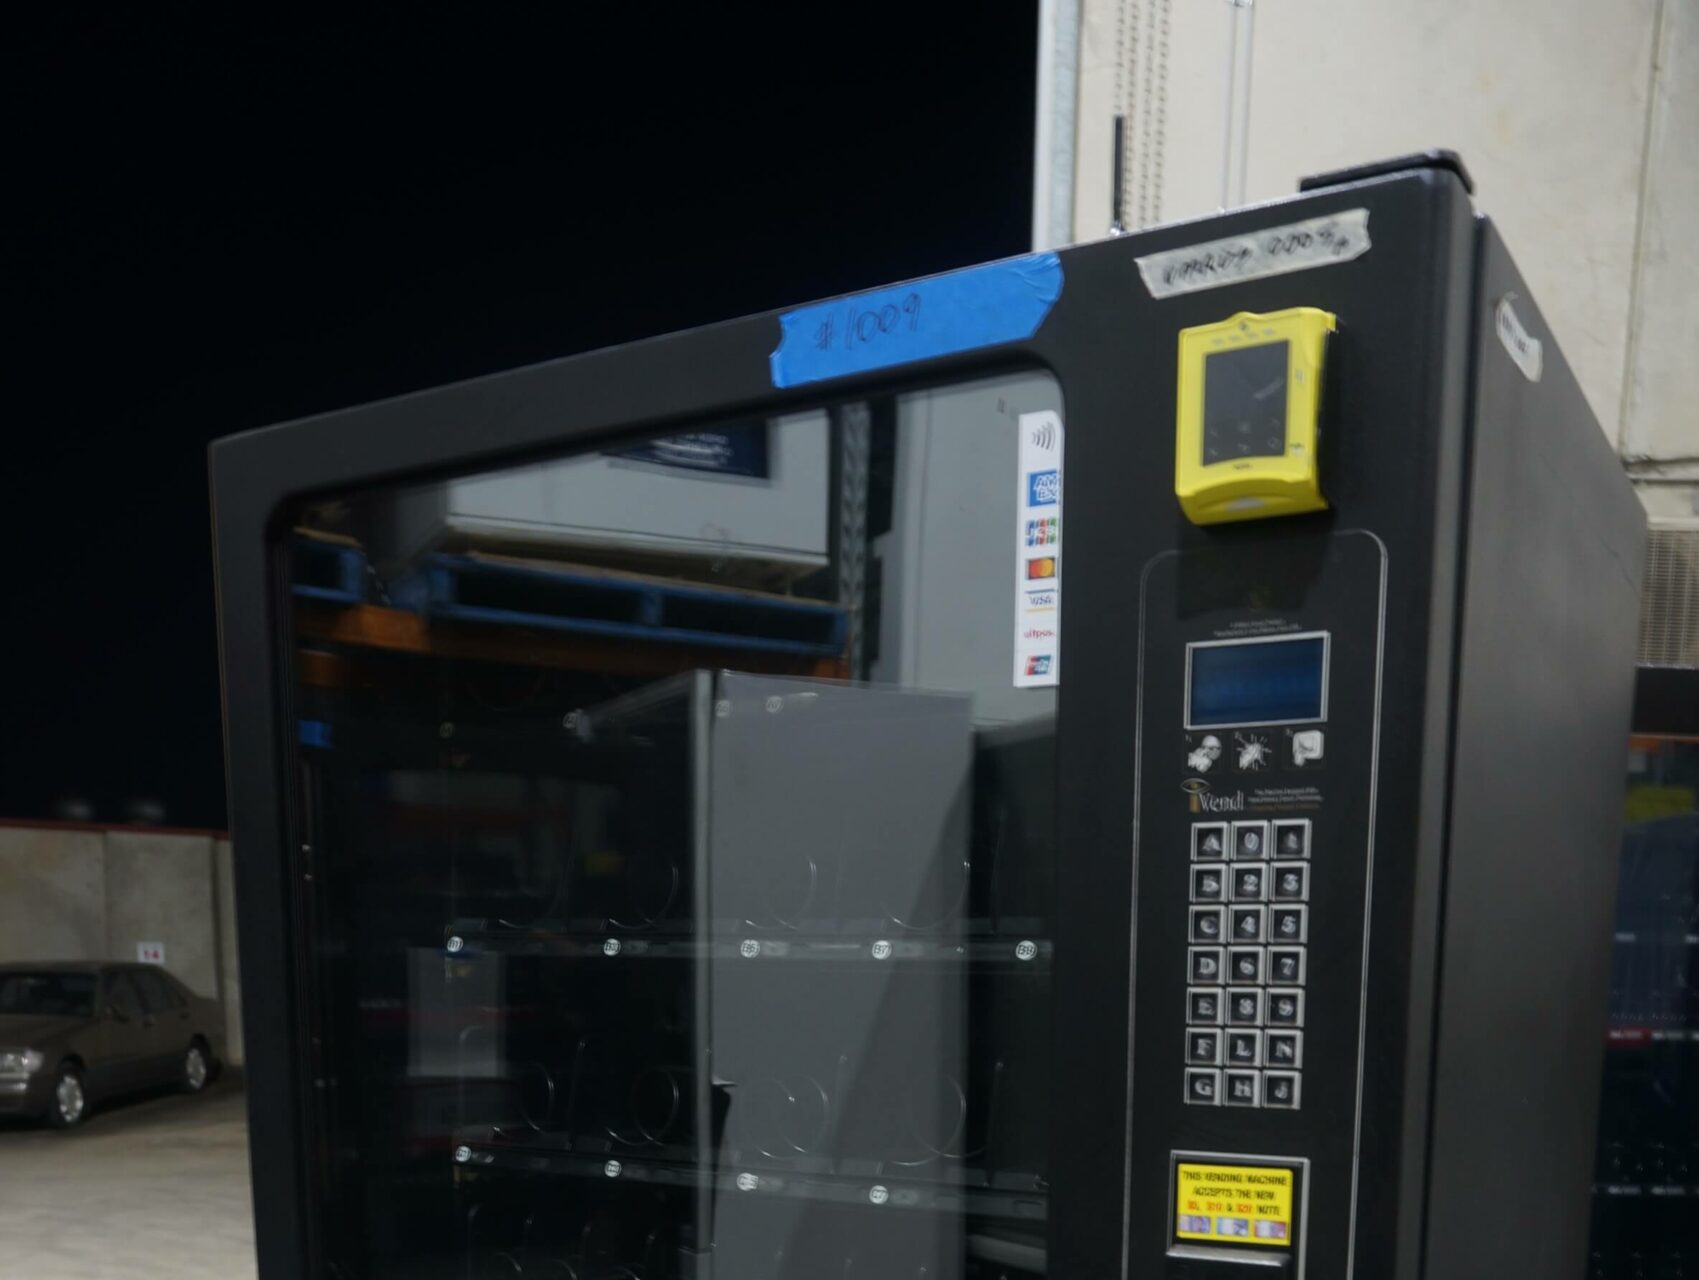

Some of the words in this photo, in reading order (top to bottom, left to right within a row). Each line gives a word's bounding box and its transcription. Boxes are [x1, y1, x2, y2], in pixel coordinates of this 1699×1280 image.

[1202, 833, 1221, 852] A
[1243, 874, 1258, 892] 2
[1282, 873, 1299, 892] 3
[1200, 915, 1218, 934] C
[1240, 915, 1256, 934] 4
[1281, 915, 1296, 934] 5
[1199, 957, 1217, 975] D
[1280, 957, 1296, 975] 7
[1196, 1038, 1213, 1056] F
[1194, 1078, 1213, 1097] G
[1183, 1170, 1201, 1181] THIS
[1205, 1172, 1242, 1184] VENDING
[1246, 1175, 1287, 1186] MACHINE
[1193, 1186, 1232, 1198] ACCEPTS
[1235, 1188, 1252, 1200] THE
[1255, 1190, 1276, 1201] NEW
